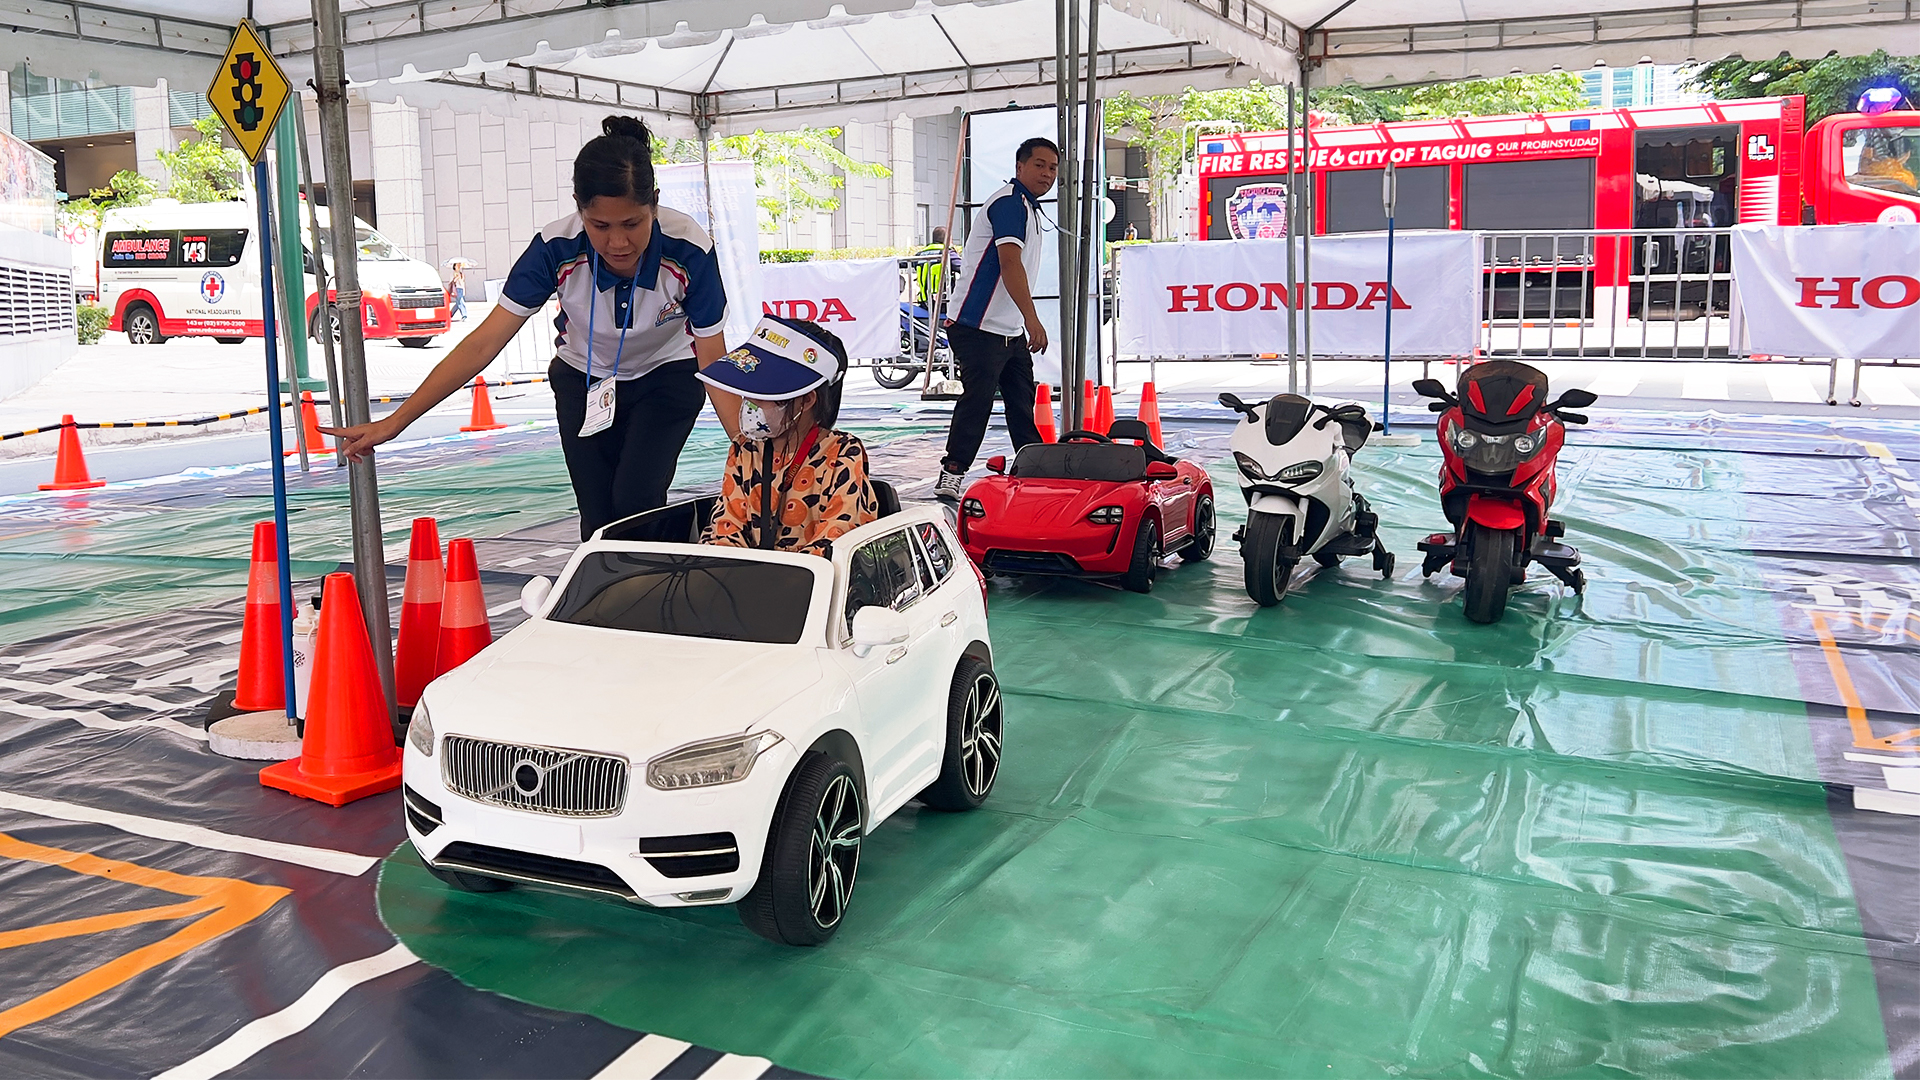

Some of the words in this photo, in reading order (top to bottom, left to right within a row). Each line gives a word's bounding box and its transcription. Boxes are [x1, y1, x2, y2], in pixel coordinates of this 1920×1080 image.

[1496, 142, 1519, 152] OUR
[1521, 137, 1599, 150] PROBINSYUDAD
[1200, 154, 1244, 174] FIRE
[1249, 149, 1329, 172] RESCUE
[1347, 149, 1388, 166] CITY
[1390, 147, 1415, 163] OF
[1420, 143, 1492, 162] TAGUIG
[111, 238, 170, 253] AMBULANCE
[182, 242, 206, 262] 143
[1166, 281, 1412, 313] HONDA
